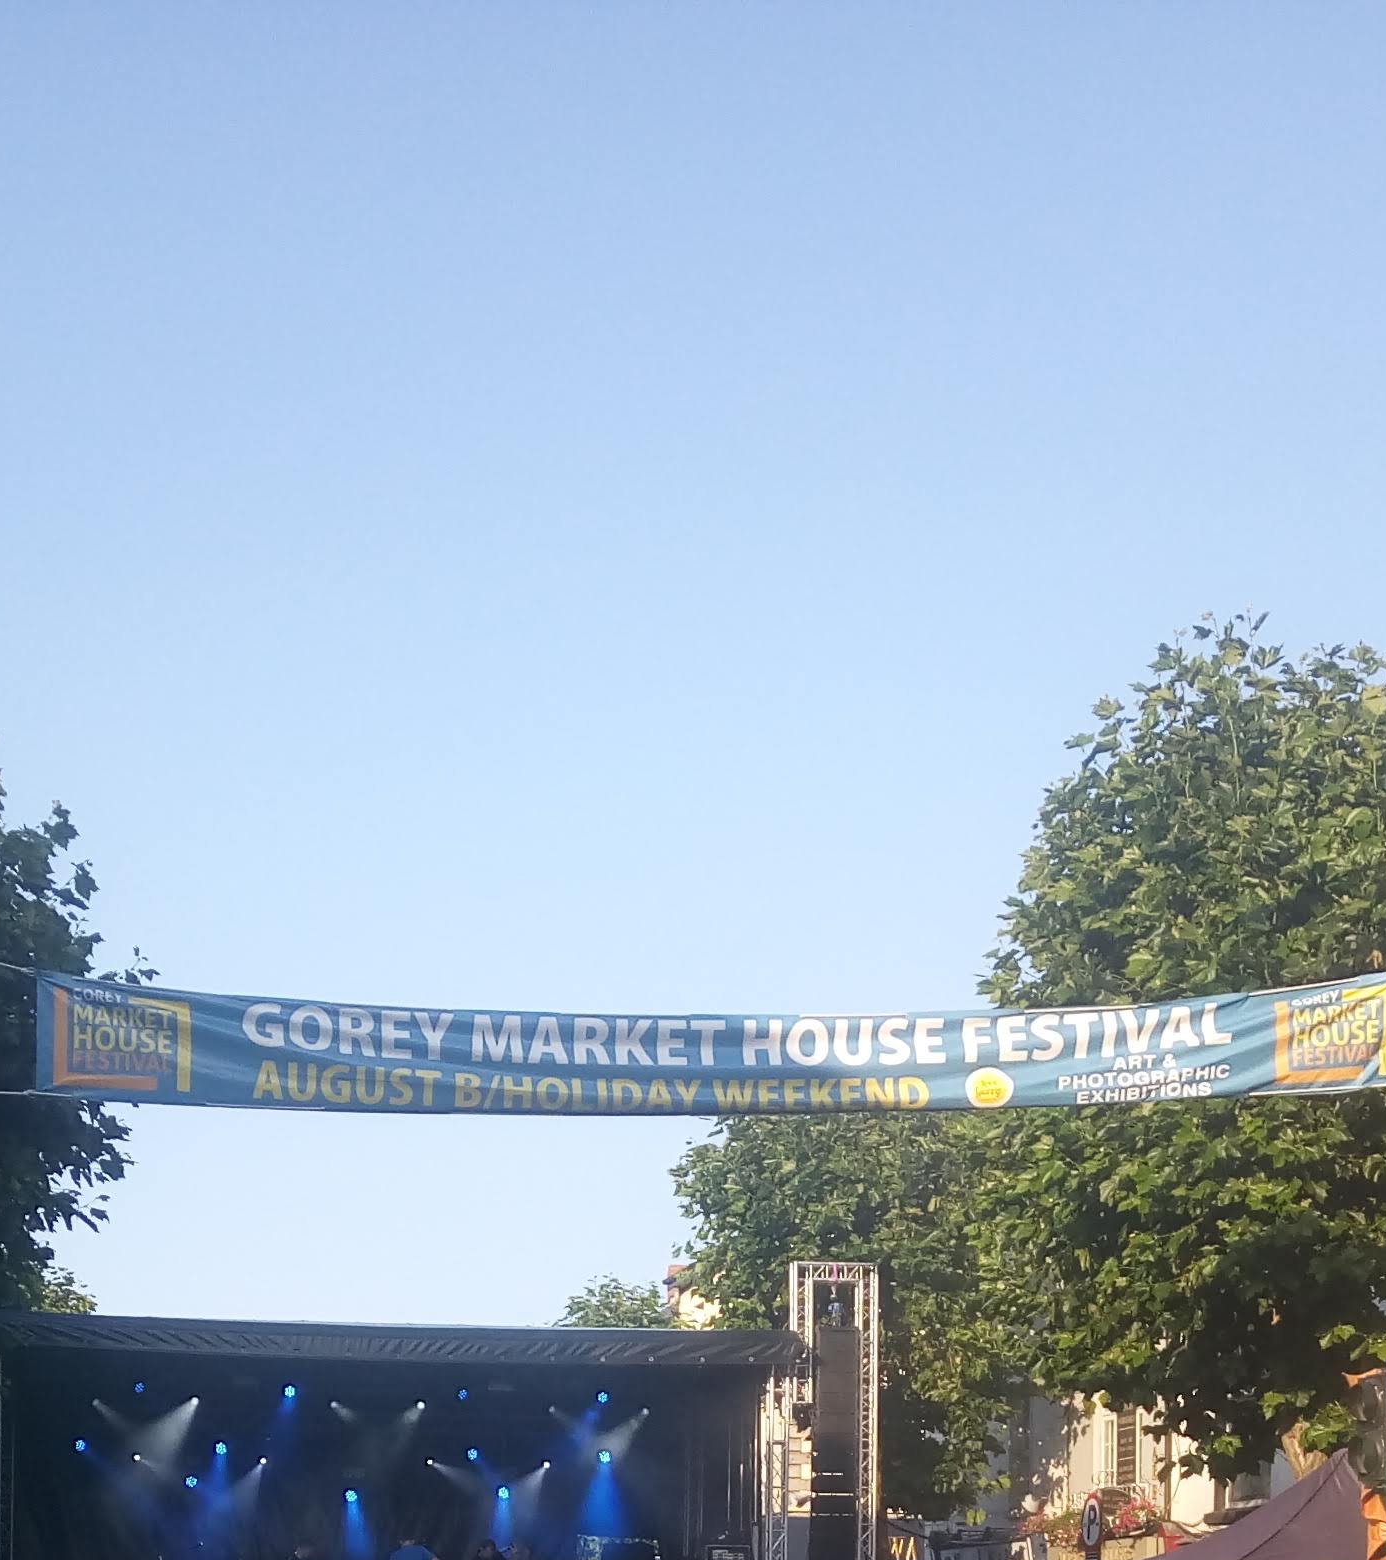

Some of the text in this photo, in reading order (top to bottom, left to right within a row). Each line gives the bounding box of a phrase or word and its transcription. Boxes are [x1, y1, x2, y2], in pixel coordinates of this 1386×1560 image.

[72, 987, 121, 1003] GOREY
[72, 1004, 173, 1029] MARKET
[1292, 999, 1380, 1028] MARKET
[72, 1023, 173, 1055] HOUSE
[242, 1000, 1232, 1066] GOREY MARKET HOUSE FESTIVAL
[1292, 1019, 1380, 1049] HOUSE
[72, 1050, 171, 1072] FESTIVAL
[1112, 1053, 1177, 1071] ART &
[1292, 1043, 1381, 1066] FESTIVAL
[253, 1059, 930, 1111] AUGUST B/HOLIDAY WEEKEND
[1058, 1063, 1231, 1090] PHOTOGRAPHIC
[1077, 1081, 1213, 1104] EXHIBITIONS
[1087, 1504, 1097, 1540] P
